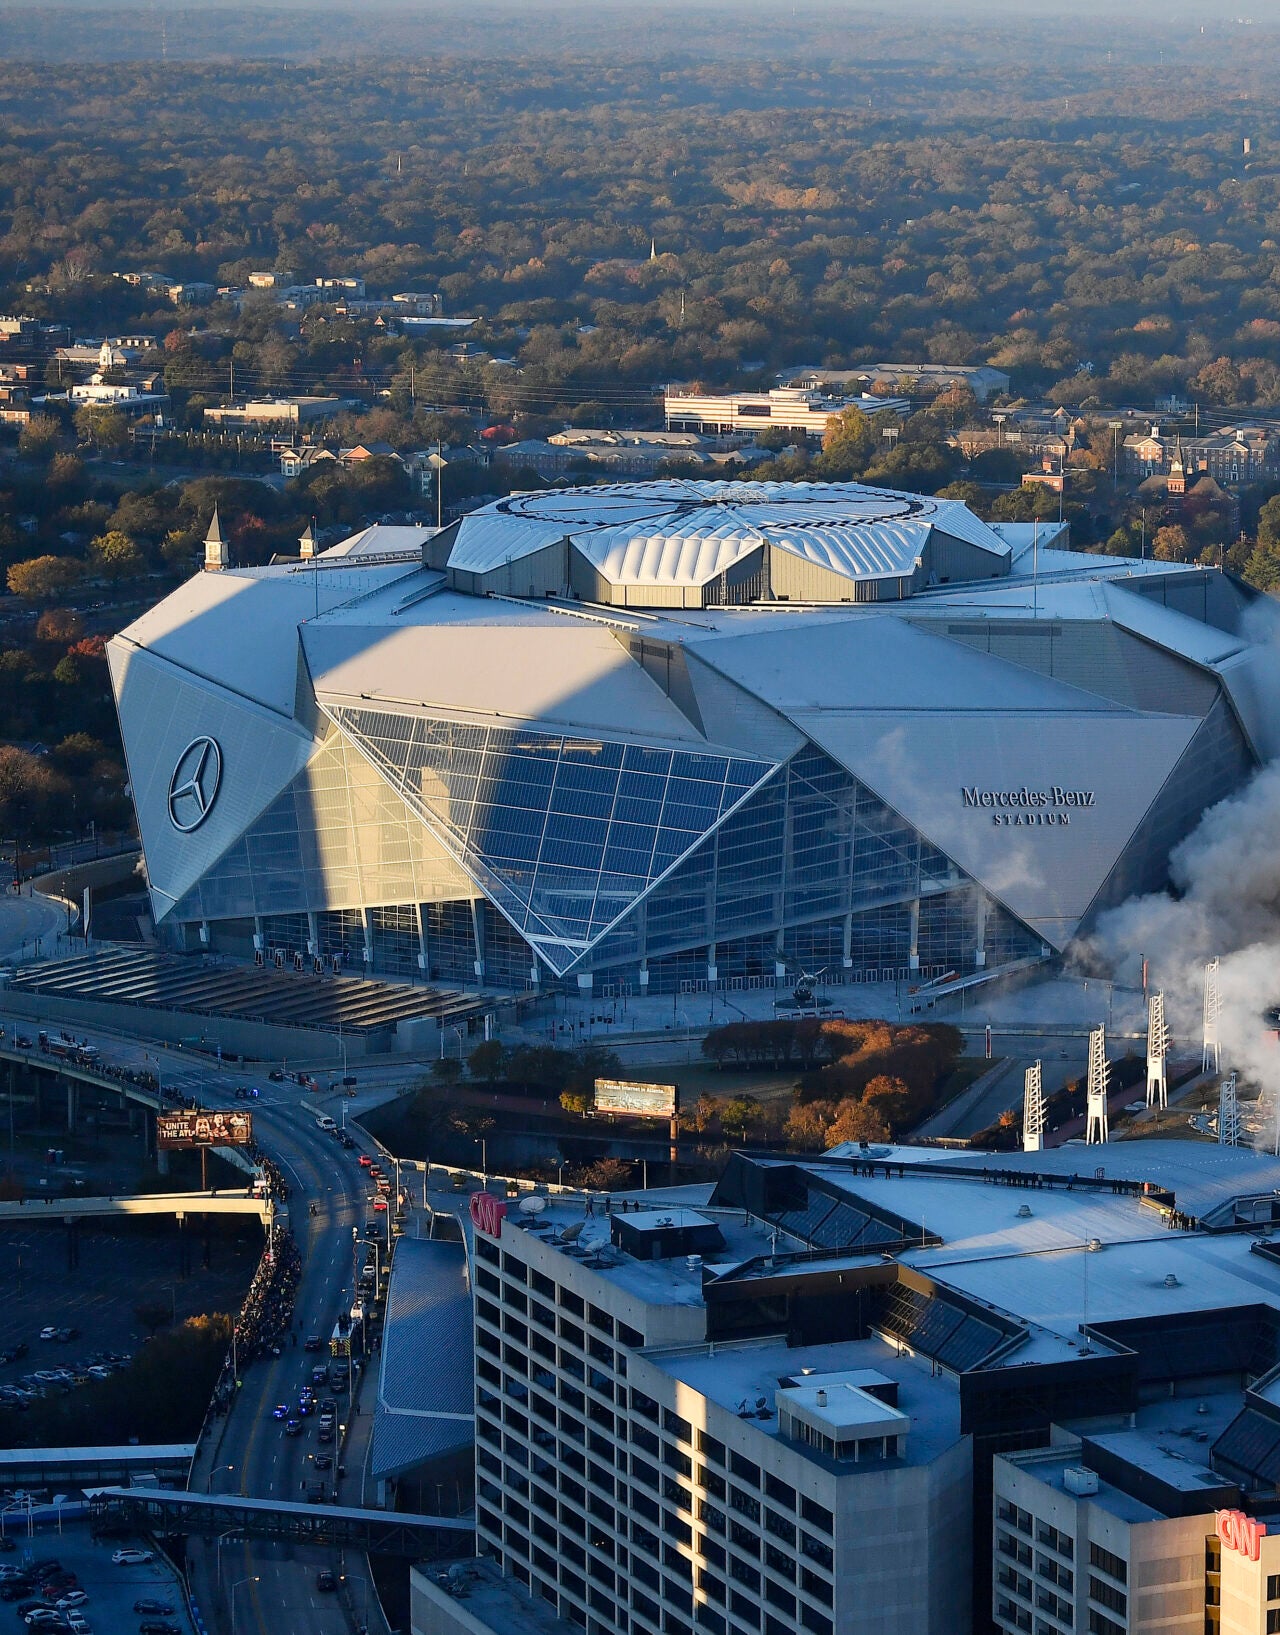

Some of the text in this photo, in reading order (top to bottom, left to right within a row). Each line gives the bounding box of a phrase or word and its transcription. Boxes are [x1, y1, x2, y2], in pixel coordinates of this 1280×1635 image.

[962, 786, 1097, 807] Mercedes-Benz
[994, 813, 1071, 825] STADIUM
[162, 1130, 178, 1138] THE
[165, 1122, 189, 1130] UNITE
[470, 1192, 503, 1239] CNN
[1216, 1508, 1261, 1562] CNN
